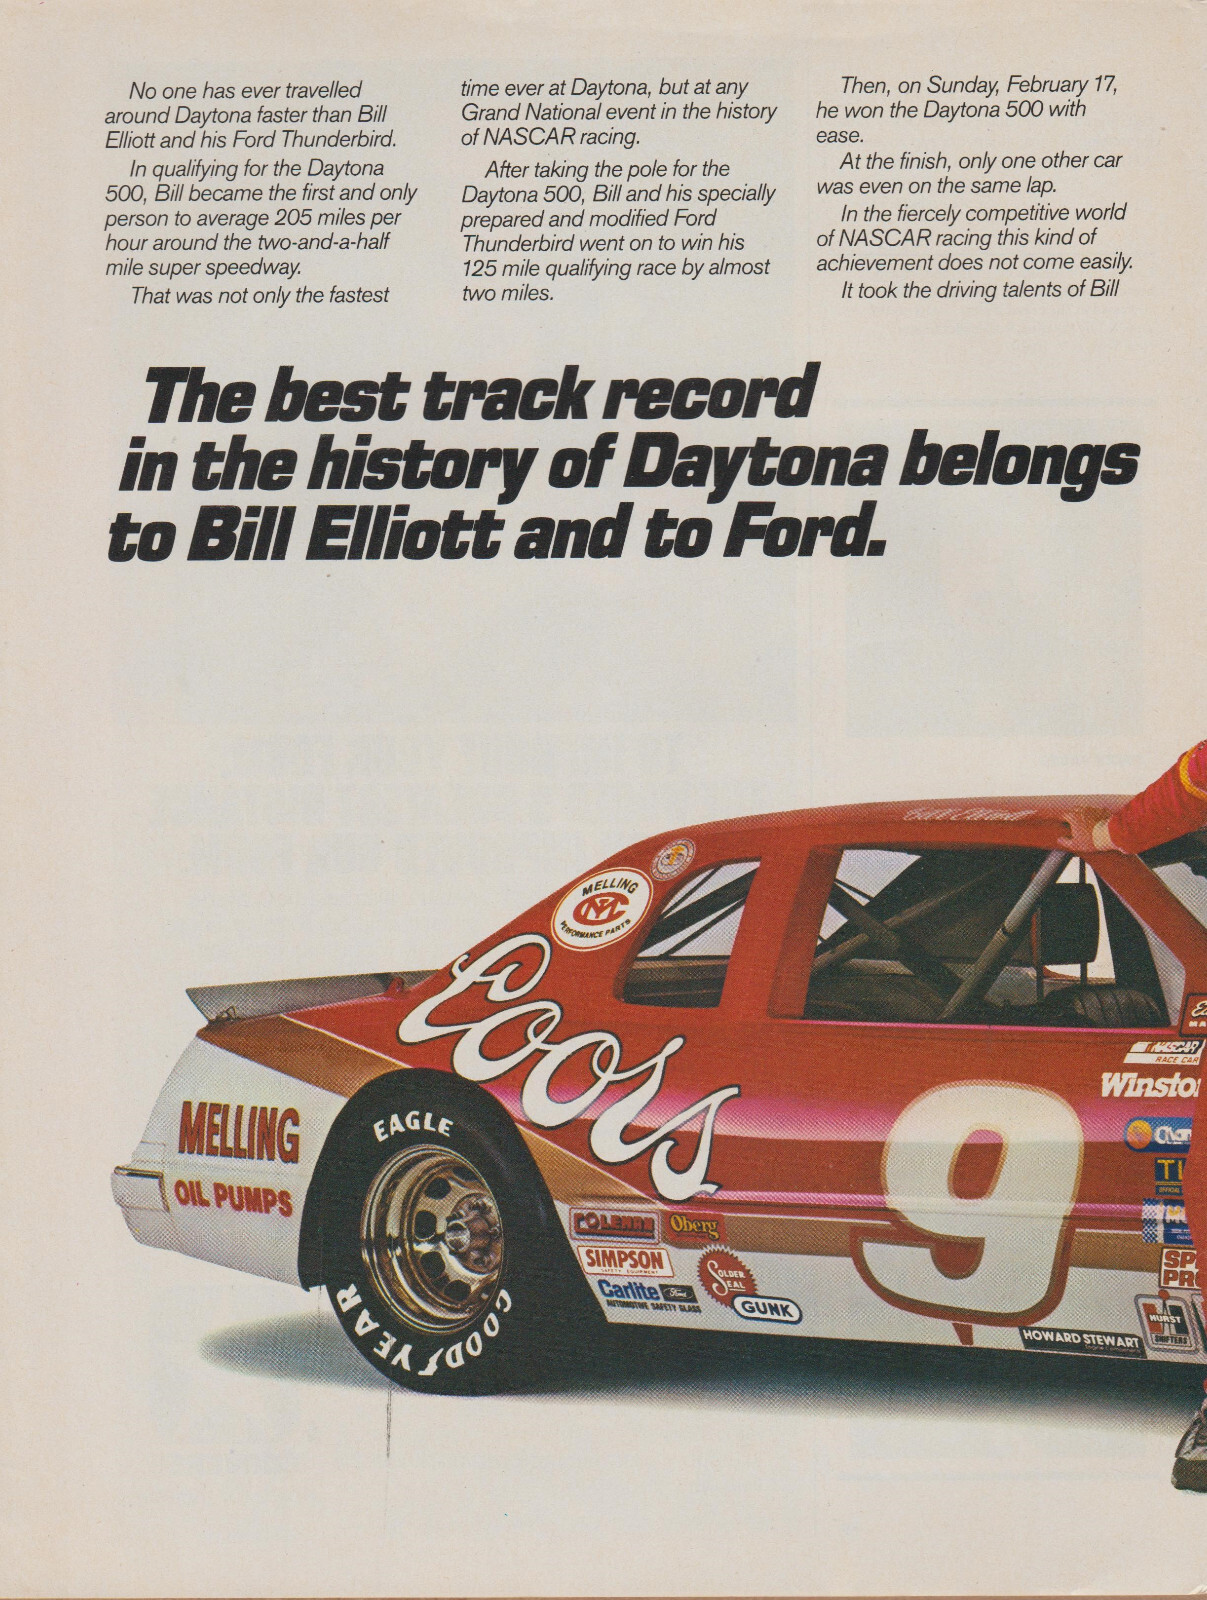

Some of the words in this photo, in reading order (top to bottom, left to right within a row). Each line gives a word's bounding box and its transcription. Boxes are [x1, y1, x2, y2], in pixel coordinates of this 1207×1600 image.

[129, 81, 157, 100] No
[162, 86, 197, 100] one
[202, 80, 236, 100] has
[241, 85, 282, 99] ever
[285, 79, 363, 99] travelled
[841, 75, 891, 98] Then,
[898, 80, 922, 94] on
[926, 74, 999, 99] Sunday,
[1006, 74, 1090, 98] February
[1095, 74, 1117, 96] 17,
[104, 105, 171, 125] around
[174, 105, 252, 129] Daytona
[256, 105, 309, 124] faster
[312, 104, 352, 123] than
[357, 104, 388, 123] Bill
[461, 102, 522, 122] Grand
[524, 102, 603, 121] National
[605, 103, 657, 120] event
[660, 101, 677, 120] in
[682, 101, 711, 120] the
[716, 101, 778, 125] history
[815, 100, 839, 119] he
[844, 105, 884, 119] won
[890, 100, 919, 119] the
[923, 99, 1000, 123] Daytona
[1005, 99, 1044, 118] 500
[1049, 98, 1087, 117] with
[105, 130, 156, 149] Elliott
[159, 130, 197, 149] and
[200, 130, 227, 149] his
[232, 129, 277, 148] Ford
[281, 128, 396, 148] Thunderbird.
[461, 127, 481, 146] of
[483, 126, 577, 146] NASCAR
[579, 126, 640, 150] racing.
[816, 130, 864, 144] ease.
[129, 159, 147, 177] In
[152, 158, 239, 183] qualifying
[243, 158, 269, 177] for
[273, 158, 302, 177] the
[307, 158, 384, 182] Daytona
[461, 185, 538, 209] Daytona
[543, 184, 585, 206] 500,
[592, 184, 623, 202] Bill
[625, 183, 663, 202] and
[665, 183, 693, 202] his
[697, 182, 777, 207] specially
[817, 181, 854, 195] was
[859, 181, 903, 195] even
[908, 181, 932, 194] on
[937, 175, 966, 194] the
[970, 180, 1022, 194] same
[1026, 175, 1057, 198] lap.
[103, 213, 169, 232] person
[174, 210, 192, 227] to
[196, 213, 270, 231] average
[274, 208, 313, 226] 205
[317, 207, 366, 226] miles
[369, 212, 402, 230] per
[841, 204, 858, 222] In
[863, 204, 892, 223] the
[897, 203, 962, 227] fiercely
[965, 202, 1070, 226] competitive
[1075, 201, 1128, 221] world
[105, 233, 149, 252] hour
[152, 232, 219, 251] around
[223, 232, 252, 251] the
[258, 231, 392, 251] two-and-a-half
[463, 233, 575, 253] Thunderbird
[579, 235, 625, 252] went
[629, 238, 653, 252] on
[658, 235, 676, 251] to
[681, 232, 713, 251] win
[718, 232, 745, 251] his
[816, 228, 836, 247] of
[838, 228, 932, 247] NASCAR
[935, 227, 993, 251] racing
[997, 227, 1029, 246] this
[1034, 227, 1075, 246] kind
[1078, 226, 1099, 246] of
[105, 257, 144, 276] mile
[148, 262, 202, 281] super
[205, 256, 301, 280] speedway.
[463, 259, 498, 277] 125
[501, 258, 540, 277] mile
[545, 257, 632, 282] qualifying
[636, 262, 677, 276] race
[681, 257, 705, 281] by
[708, 257, 771, 276] almost
[816, 253, 934, 272] achievement
[938, 252, 984, 271] does
[988, 254, 1020, 271] not
[1023, 256, 1075, 270] come
[1079, 251, 1133, 275] easily.
[462, 285, 497, 302] two
[501, 283, 554, 301] miles.
[145, 366, 257, 424] The
[264, 365, 412, 423] best
[422, 364, 596, 421] track
[602, 361, 822, 420] record
[118, 435, 179, 492] in
[191, 434, 298, 492] the
[306, 433, 540, 506] history
[548, 431, 619, 489] of
[622, 431, 889, 505] Daytona
[898, 428, 1141, 503] belongs
[107, 512, 177, 563] to
[186, 504, 297, 561] Bill
[305, 504, 506, 561] Elliott
[513, 501, 635, 560] and
[644, 508, 713, 559] to
[722, 499, 887, 558] Ford.
[582, 877, 639, 897] MELLING
[560, 919, 604, 939] PERFORMANCE
[605, 918, 632, 937] PARTS
[397, 932, 742, 1202] Coors
[1155, 1056, 1179, 1064] RACE
[1181, 1056, 1200, 1064] CAR
[178, 1099, 301, 1165] MELLING
[373, 1110, 454, 1143] EAGLE
[173, 1179, 211, 1208] OIL
[213, 1182, 294, 1218] PUMPS
[855, 1080, 1084, 1325] 9
[669, 1213, 720, 1241] Oberg
[585, 1248, 664, 1270] SIMPSON
[1163, 1250, 1198, 1269] SP
[598, 1278, 662, 1302] Carlite
[1162, 1269, 1200, 1288] PR
[606, 1299, 650, 1311] AUTOMOTIVE
[651, 1302, 678, 1312] SAFETY
[678, 1303, 702, 1314] GLASS
[741, 1300, 794, 1318] GUNK
[1149, 1314, 1182, 1324] HURST
[1022, 1329, 1081, 1344] HOWARD
[1082, 1333, 1139, 1349] STEWART
[1154, 1335, 1189, 1345] SHIFTERS
